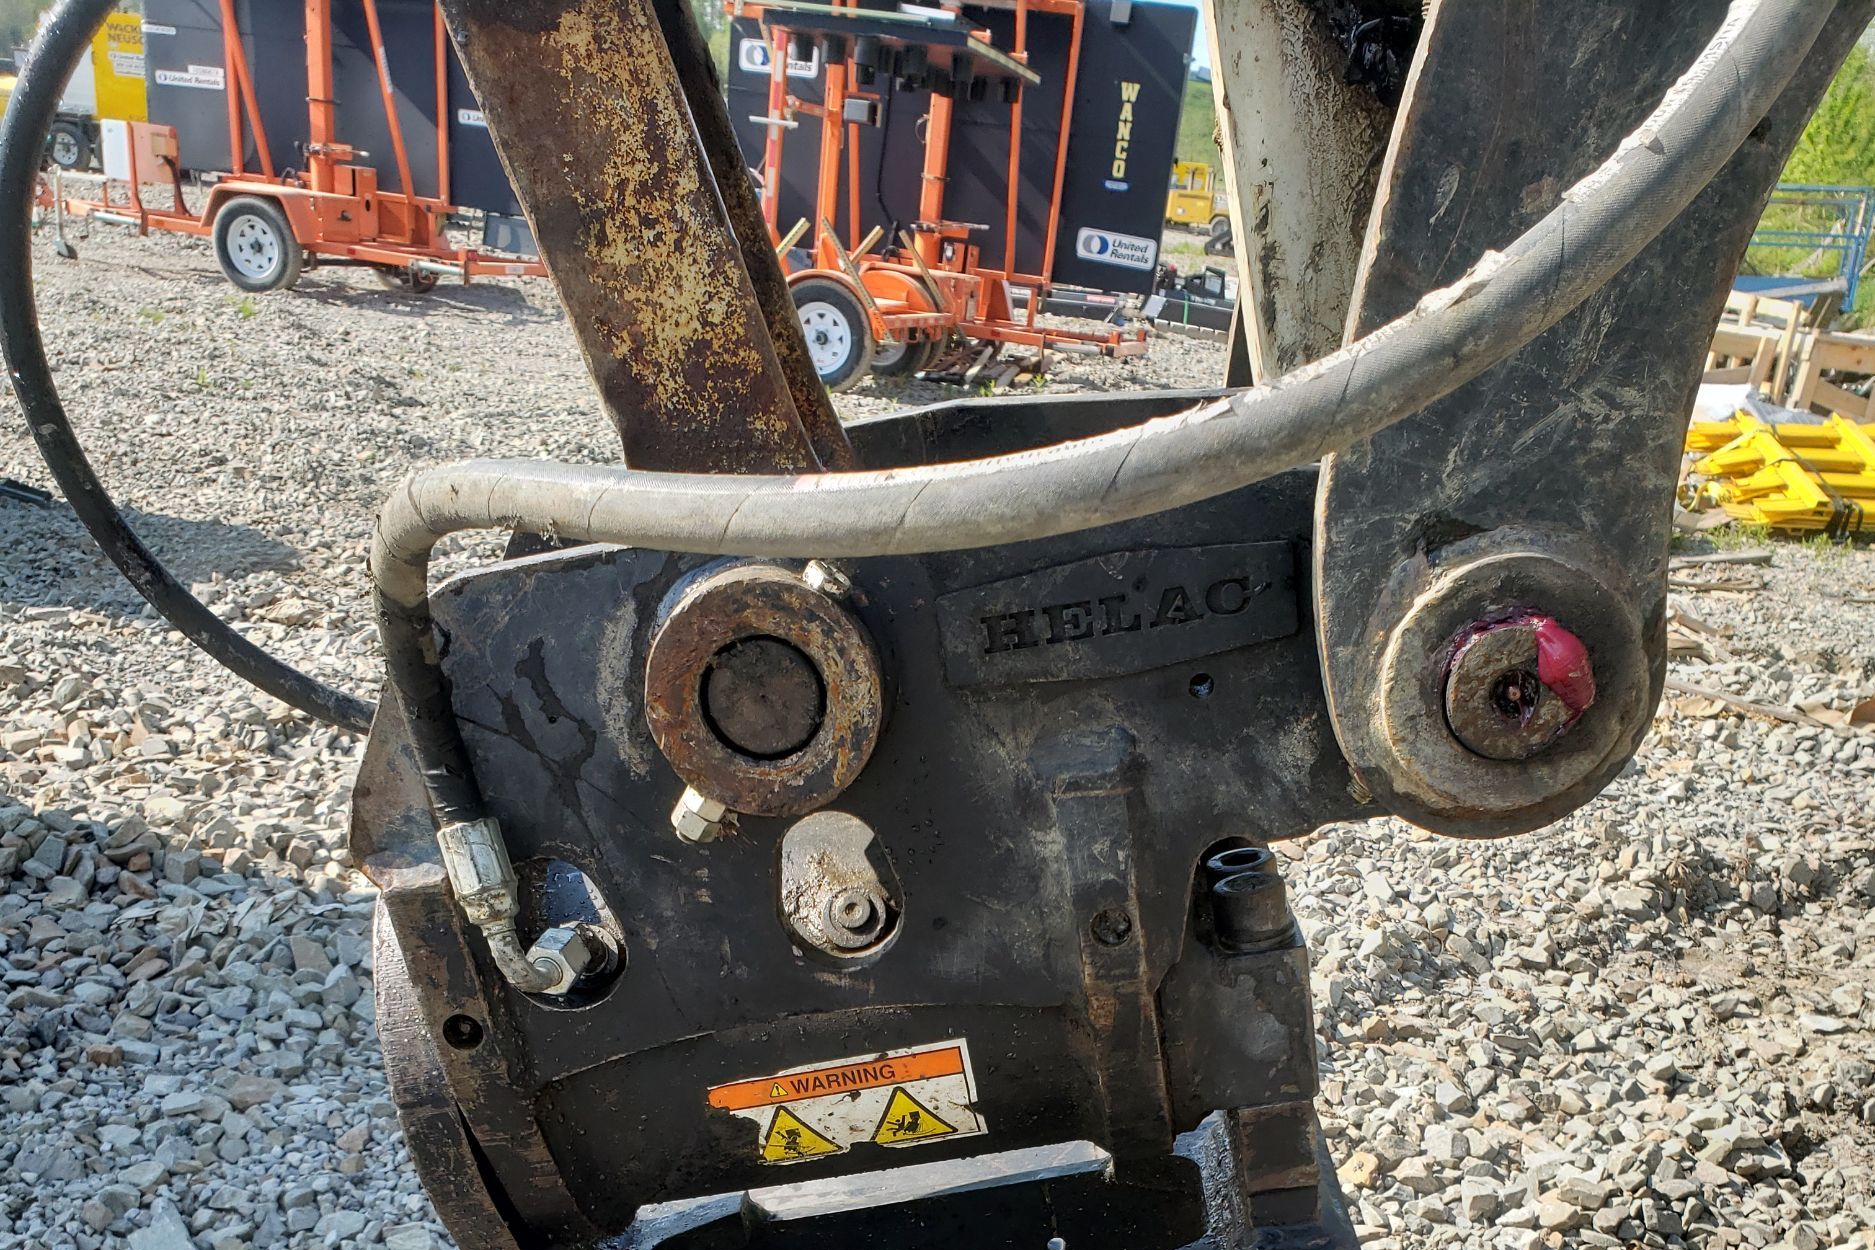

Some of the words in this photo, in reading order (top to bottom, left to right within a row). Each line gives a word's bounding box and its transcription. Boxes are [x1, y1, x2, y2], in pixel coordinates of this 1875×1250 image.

[168, 73, 193, 83] United
[194, 77, 220, 86] Rentals
[1112, 81, 1141, 178] WANCO
[1109, 249, 1149, 265] Rentals
[1112, 238, 1149, 254] United
[980, 576, 1252, 655] HELAC
[790, 1064, 897, 1094] WARNING
